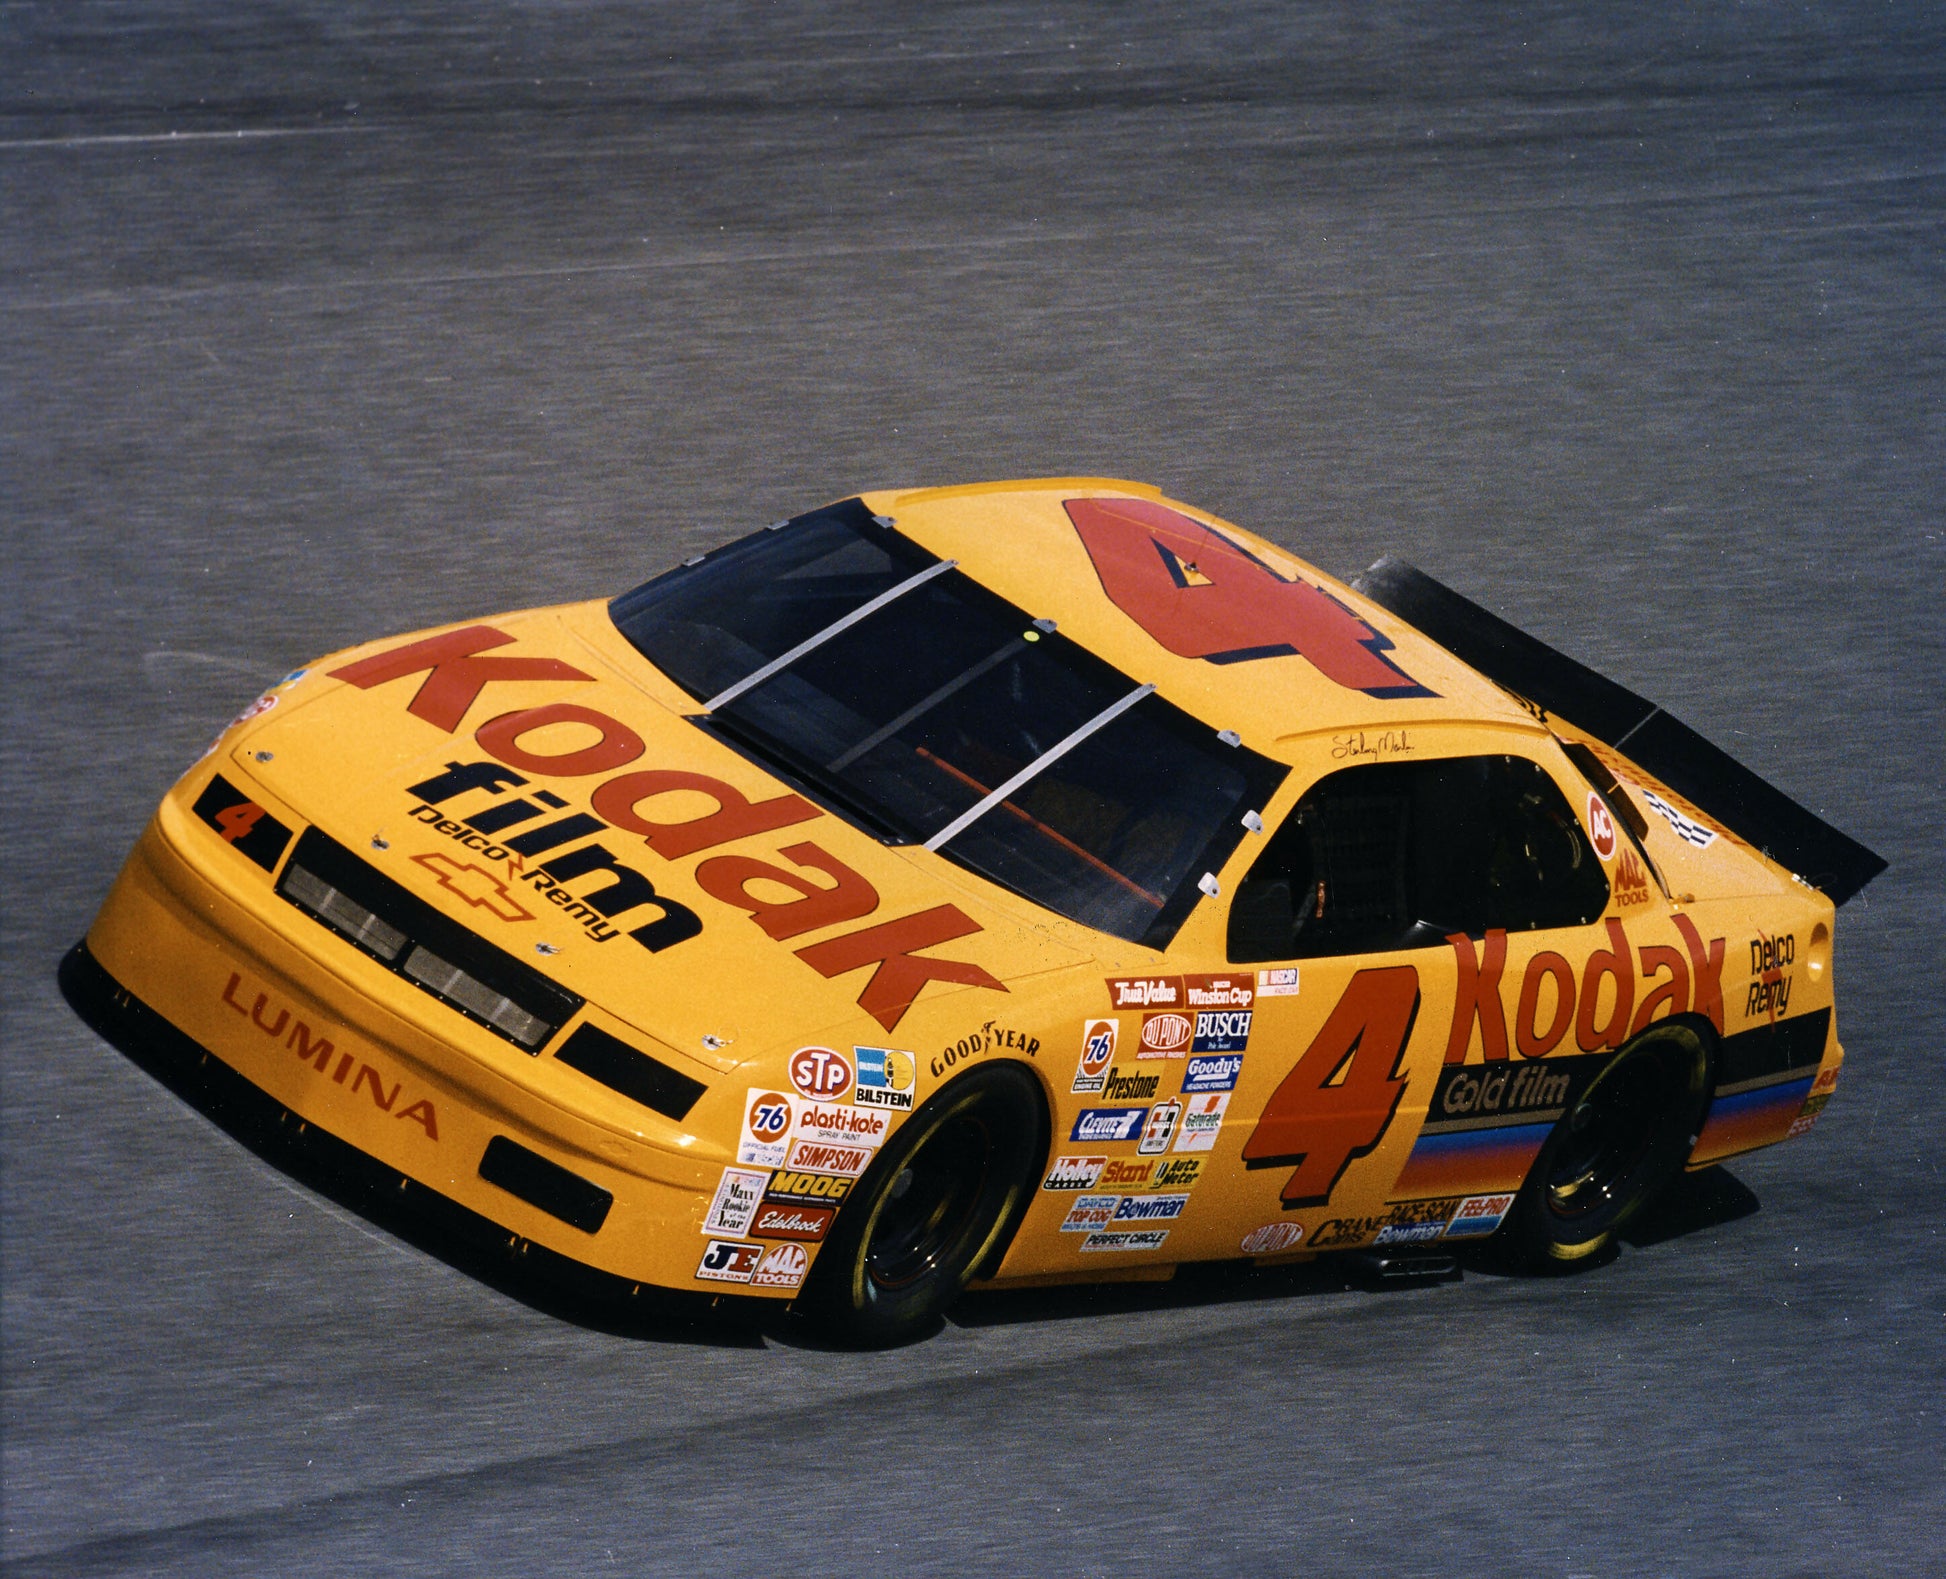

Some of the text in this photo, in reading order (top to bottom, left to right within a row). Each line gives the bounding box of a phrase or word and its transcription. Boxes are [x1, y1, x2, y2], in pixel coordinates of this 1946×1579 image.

[1062, 498, 1445, 700] 4
[213, 802, 267, 843] 4
[326, 624, 1011, 1034] Kodak
[1593, 808, 1612, 840] AC
[405, 761, 703, 954] film
[1614, 848, 1648, 893] MAC
[407, 805, 621, 942] Delco Remy
[1614, 889, 1649, 908] TOOLS
[1749, 933, 1795, 976] Delco
[1188, 985, 1253, 1006] Winston Cup
[1443, 912, 1726, 1066] Kodak
[1744, 975, 1792, 1018] Remy
[1194, 1012, 1252, 1038] BUSCH
[220, 972, 440, 1142] LUMINA
[930, 1022, 1040, 1078] GOODYEAR
[1085, 1033, 1110, 1062] 76
[796, 1052, 845, 1093] STP
[1187, 1057, 1242, 1080] Goody's
[1102, 1067, 1160, 1099] Prestone
[1241, 964, 1422, 1211] 4
[1443, 1065, 1571, 1115] Gold film
[856, 1088, 912, 1107] BILSTEIN
[754, 1104, 787, 1132] 76
[800, 1105, 884, 1134] plasti-kote
[1079, 1112, 1117, 1133] CLEVITE
[818, 1129, 861, 1141] SPRAY PAINT
[794, 1145, 866, 1171] SIMPSON
[1101, 1159, 1155, 1184] Stant
[1169, 1159, 1200, 1172] Auto
[769, 1172, 849, 1198] MOOG
[1049, 1158, 1103, 1186] Holley
[1160, 1172, 1200, 1185] Meter
[729, 1183, 754, 1200] Maxx
[717, 1210, 744, 1228] Year
[721, 1198, 751, 1213] Rookie
[1066, 1210, 1091, 1223] TOP
[1114, 1197, 1186, 1219] Bowman
[758, 1211, 825, 1233] Edelbrock
[1374, 1224, 1445, 1245] Bowman
[1086, 1232, 1166, 1245] PERFECT CIRCLE
[704, 1244, 761, 1273] JE
[760, 1246, 805, 1274] MAC
[698, 1270, 750, 1280] PISTONS
[756, 1273, 800, 1285] TOOLS
